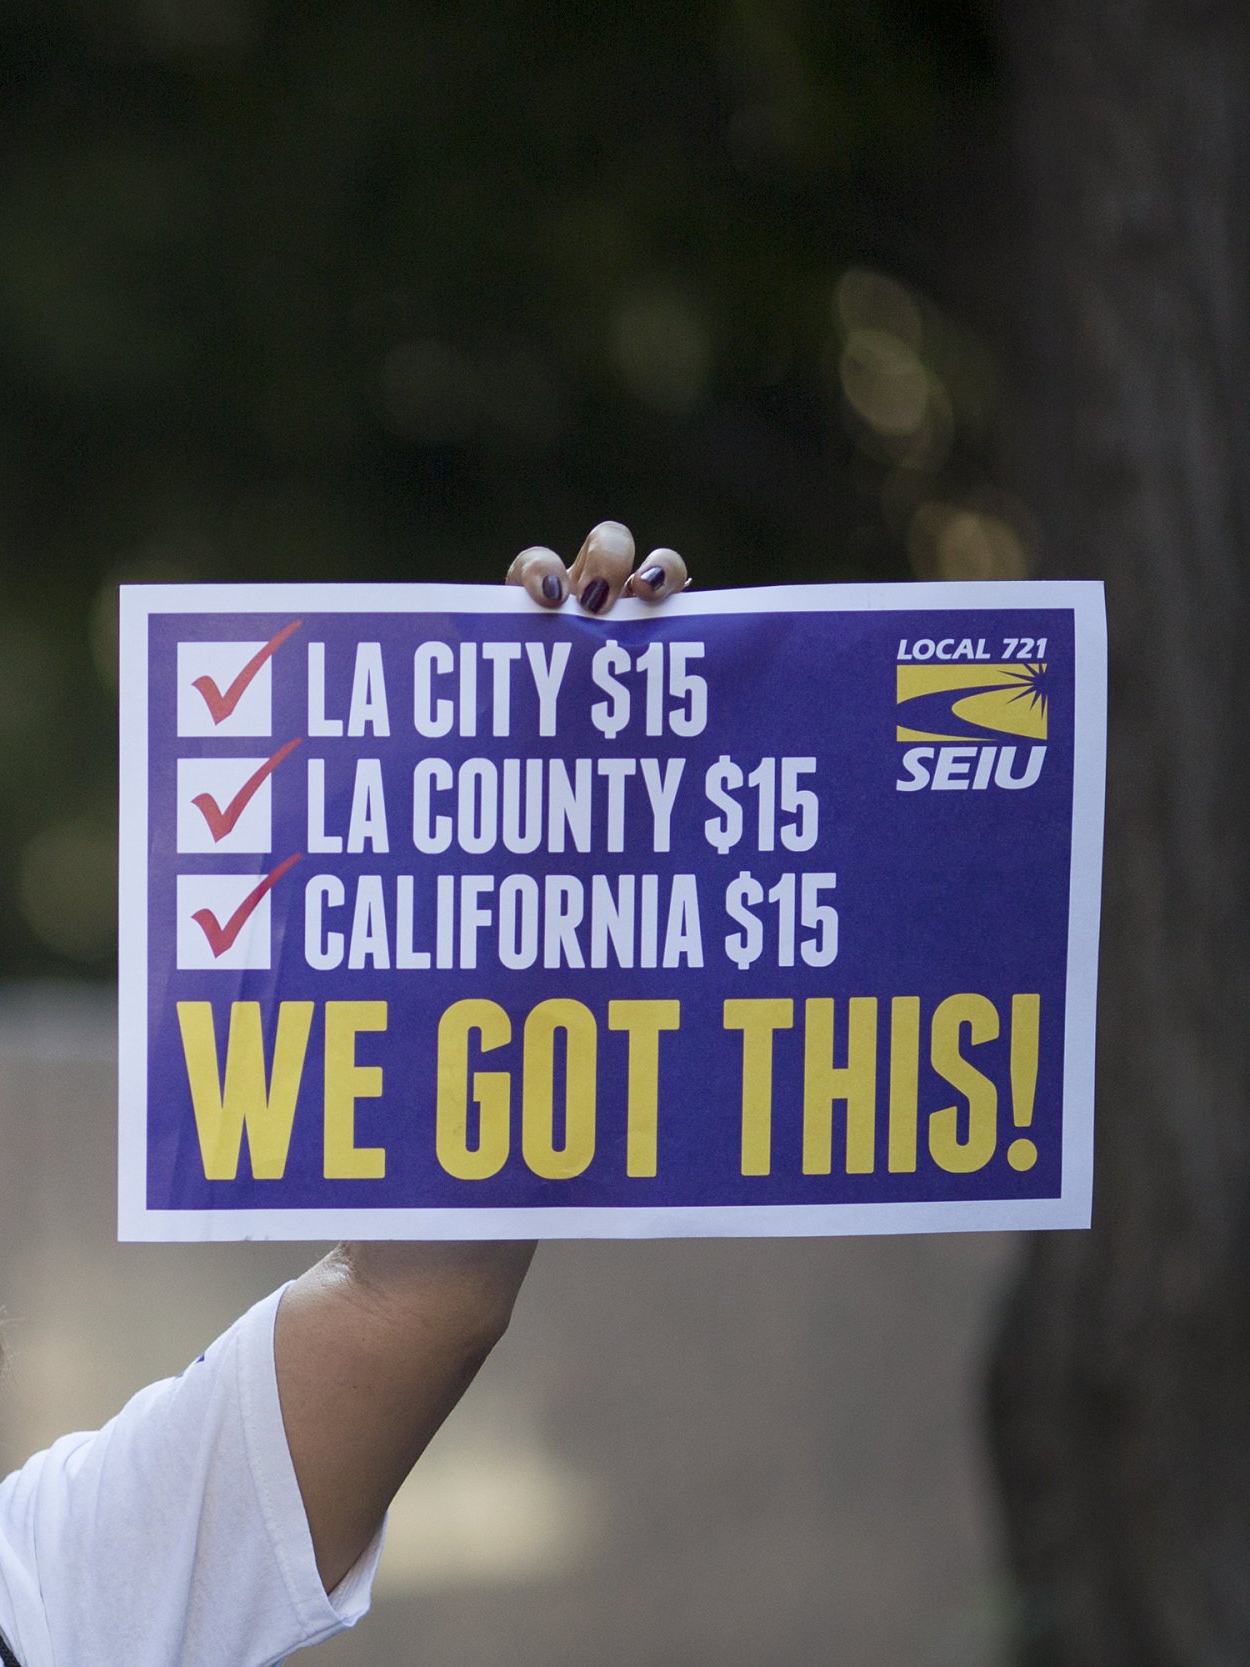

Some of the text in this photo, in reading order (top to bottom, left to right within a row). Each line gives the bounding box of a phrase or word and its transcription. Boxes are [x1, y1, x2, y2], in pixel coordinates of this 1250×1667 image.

[308, 640, 707, 739] LA CITY $15
[897, 638, 1048, 660] LOCAL 721
[308, 755, 818, 854] LA COUNTY $15
[896, 746, 1047, 792] SEIU
[305, 871, 838, 970] CALIFORNIA $15
[176, 993, 1041, 1180] WE GOT THIS!
